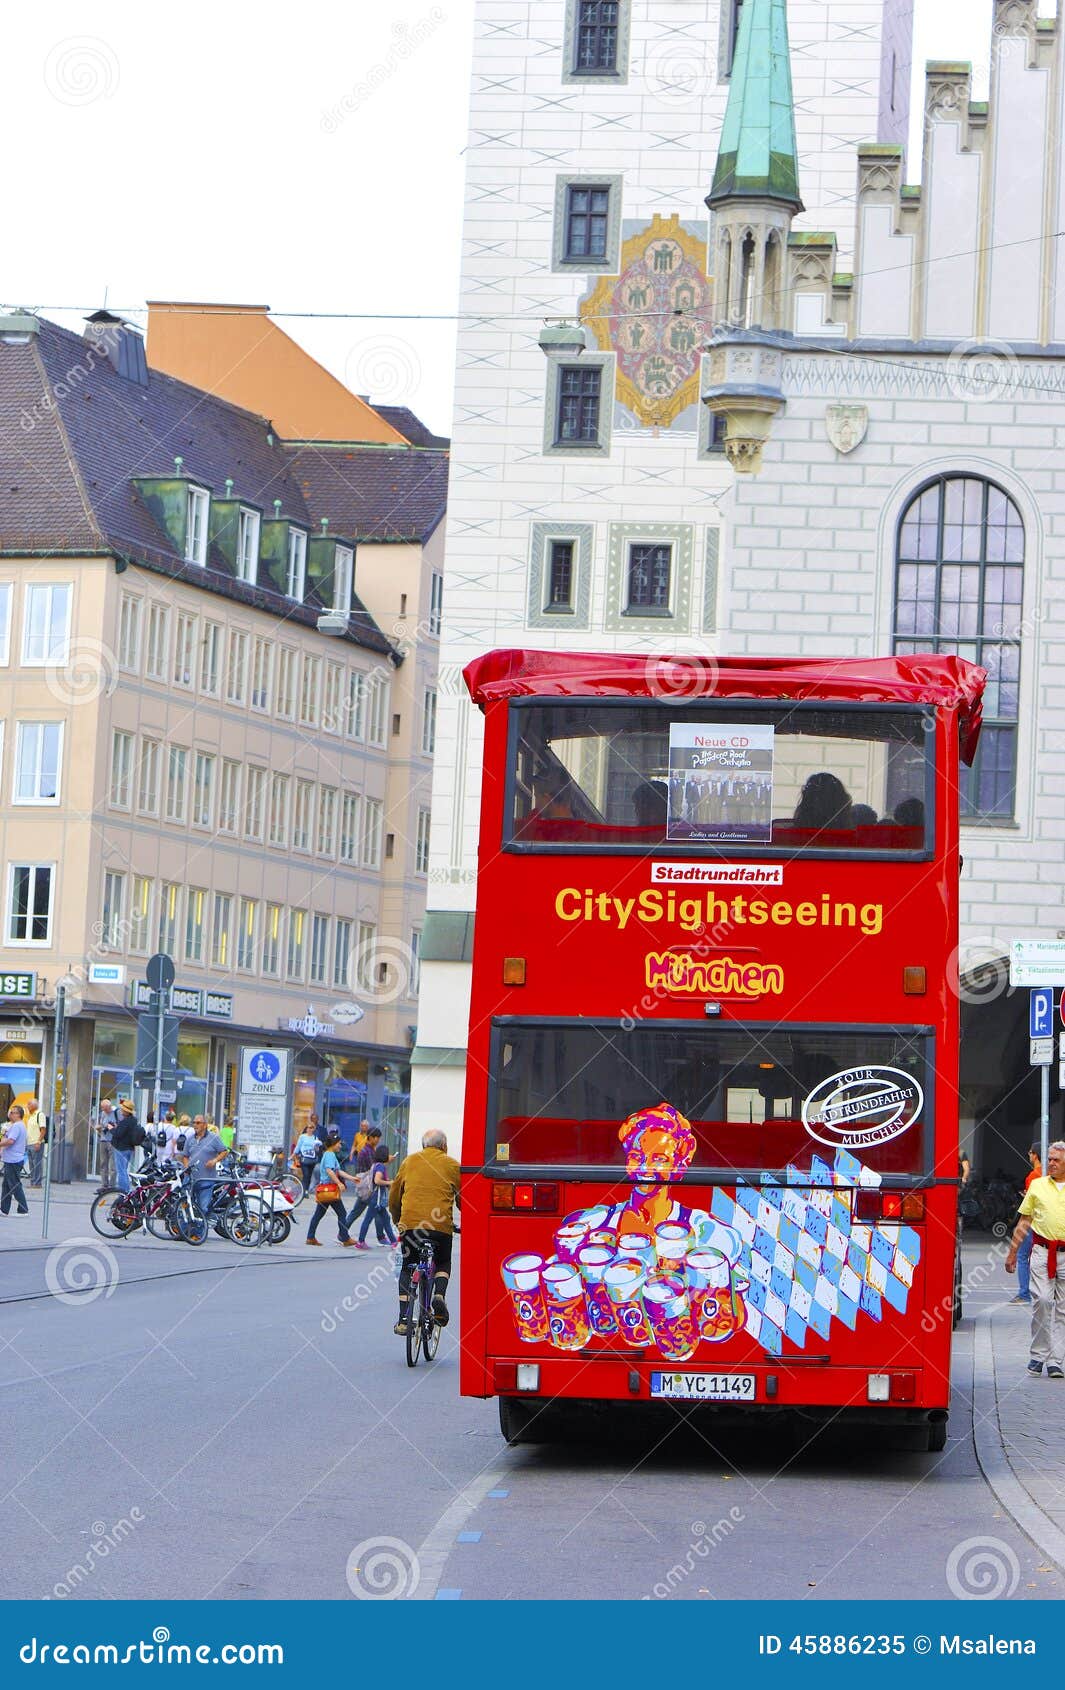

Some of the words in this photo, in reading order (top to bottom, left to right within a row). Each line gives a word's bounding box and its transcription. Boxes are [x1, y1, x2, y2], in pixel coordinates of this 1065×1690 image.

[694, 736, 727, 747] Neue
[730, 737, 749, 747] CD
[655, 866, 780, 882] Stadtrundfahrt
[555, 888, 883, 935] CitySightseeing
[645, 951, 784, 996] München
[0, 976, 28, 993] SE
[1035, 995, 1048, 1031] P
[835, 1070, 874, 1087] TOUR
[252, 1084, 275, 1093] ZONE
[810, 1088, 914, 1125] STADTRUNDFAHRT
[662, 1376, 673, 1391] M
[685, 1377, 706, 1393] YC
[710, 1377, 752, 1394] 1149
